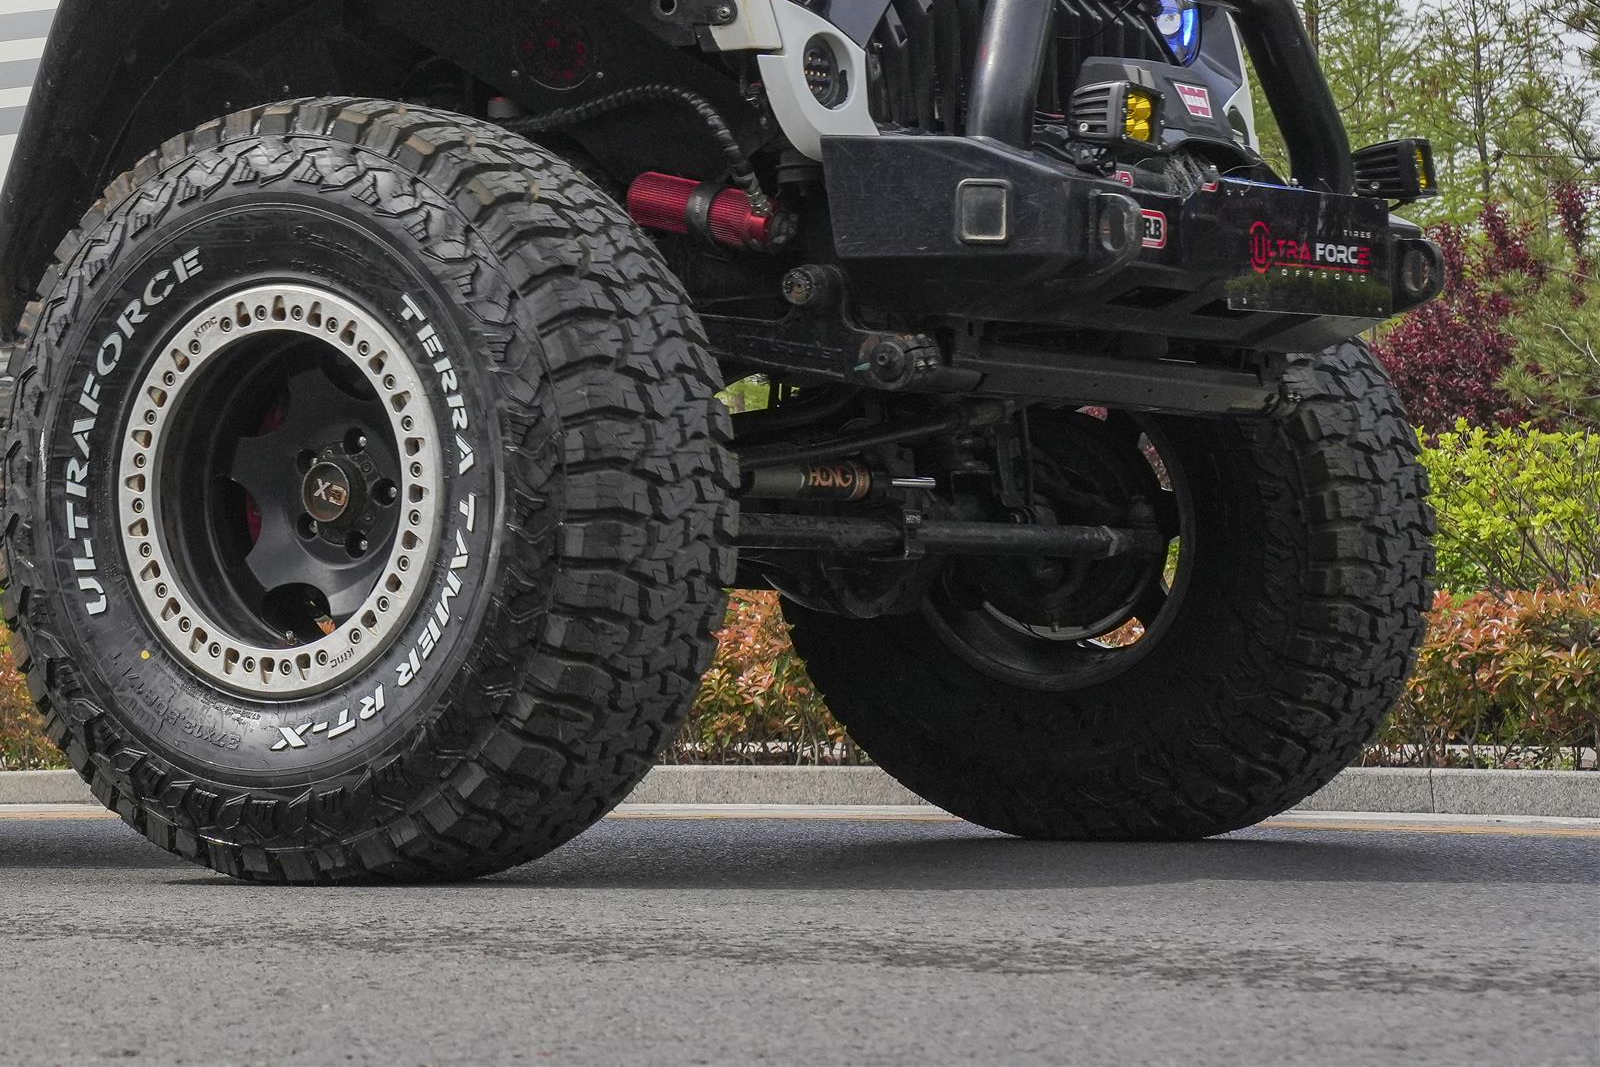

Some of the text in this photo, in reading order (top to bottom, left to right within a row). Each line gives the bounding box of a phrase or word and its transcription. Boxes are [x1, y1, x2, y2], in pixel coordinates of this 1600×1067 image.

[1344, 230, 1371, 239] TIRES
[1315, 243, 1372, 265] FORCE
[1282, 269, 1366, 283] OFFROAD
[63, 246, 204, 616] ULTRAFORCE
[270, 292, 478, 752] TERRA TAMER RT-X
